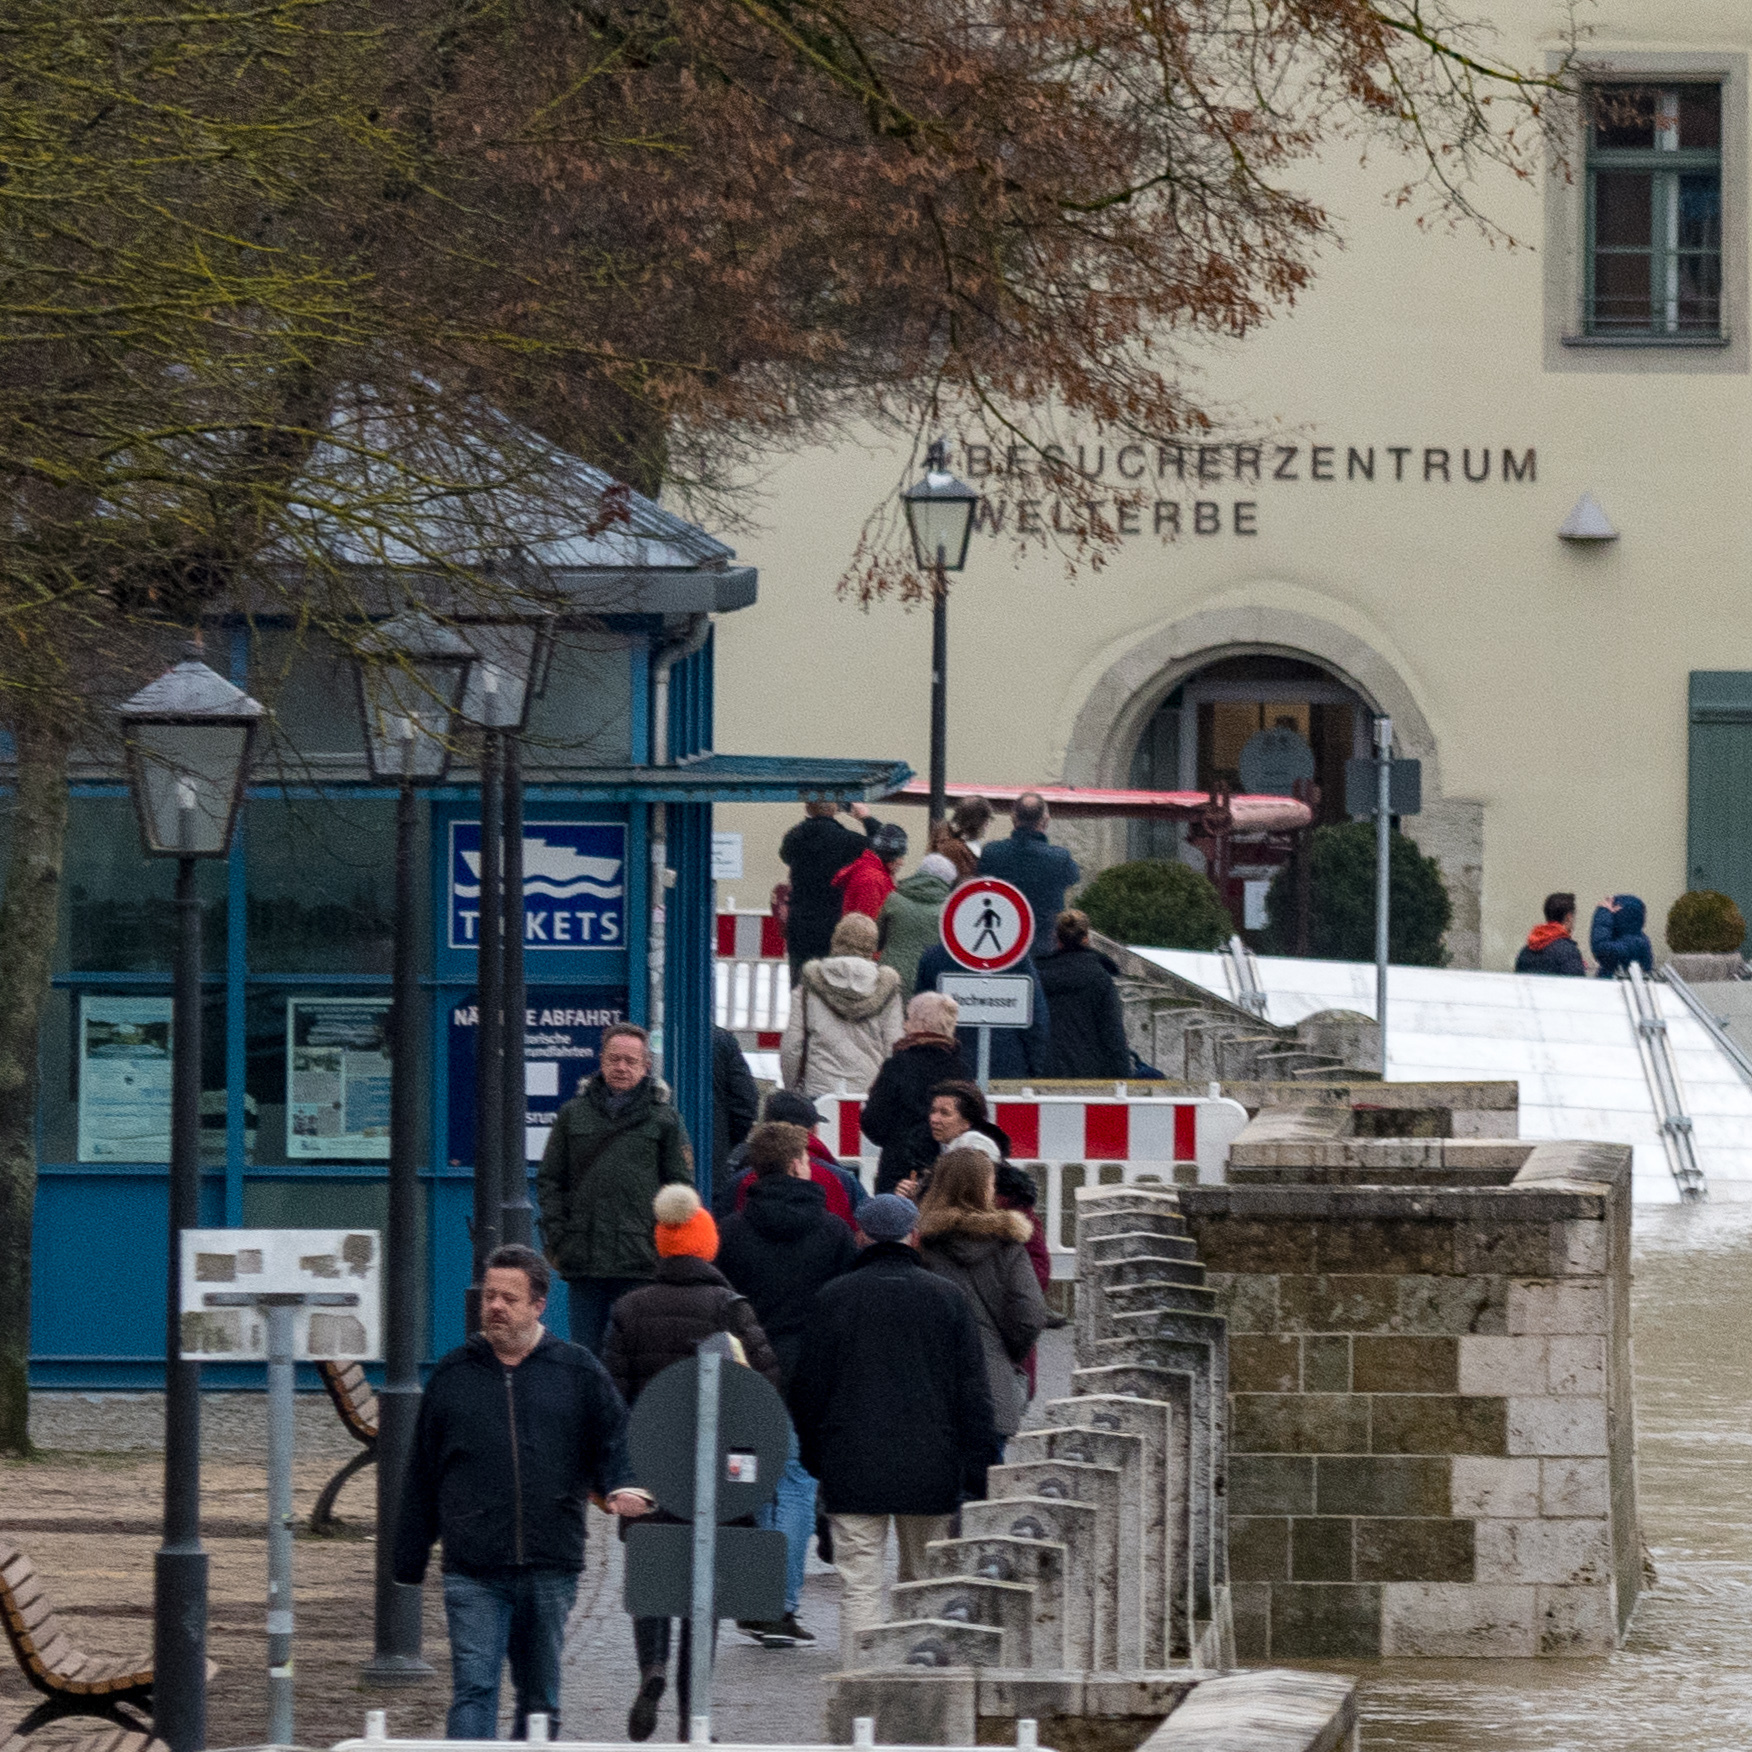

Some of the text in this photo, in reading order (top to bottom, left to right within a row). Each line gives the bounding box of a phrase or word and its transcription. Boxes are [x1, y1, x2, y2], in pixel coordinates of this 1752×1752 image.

[966, 444, 1539, 483] BESUCHERZENTRUM
[973, 499, 1259, 536] WELTERBE
[458, 910, 620, 941] TKETS
[540, 1008, 623, 1027] ABFAHRT
